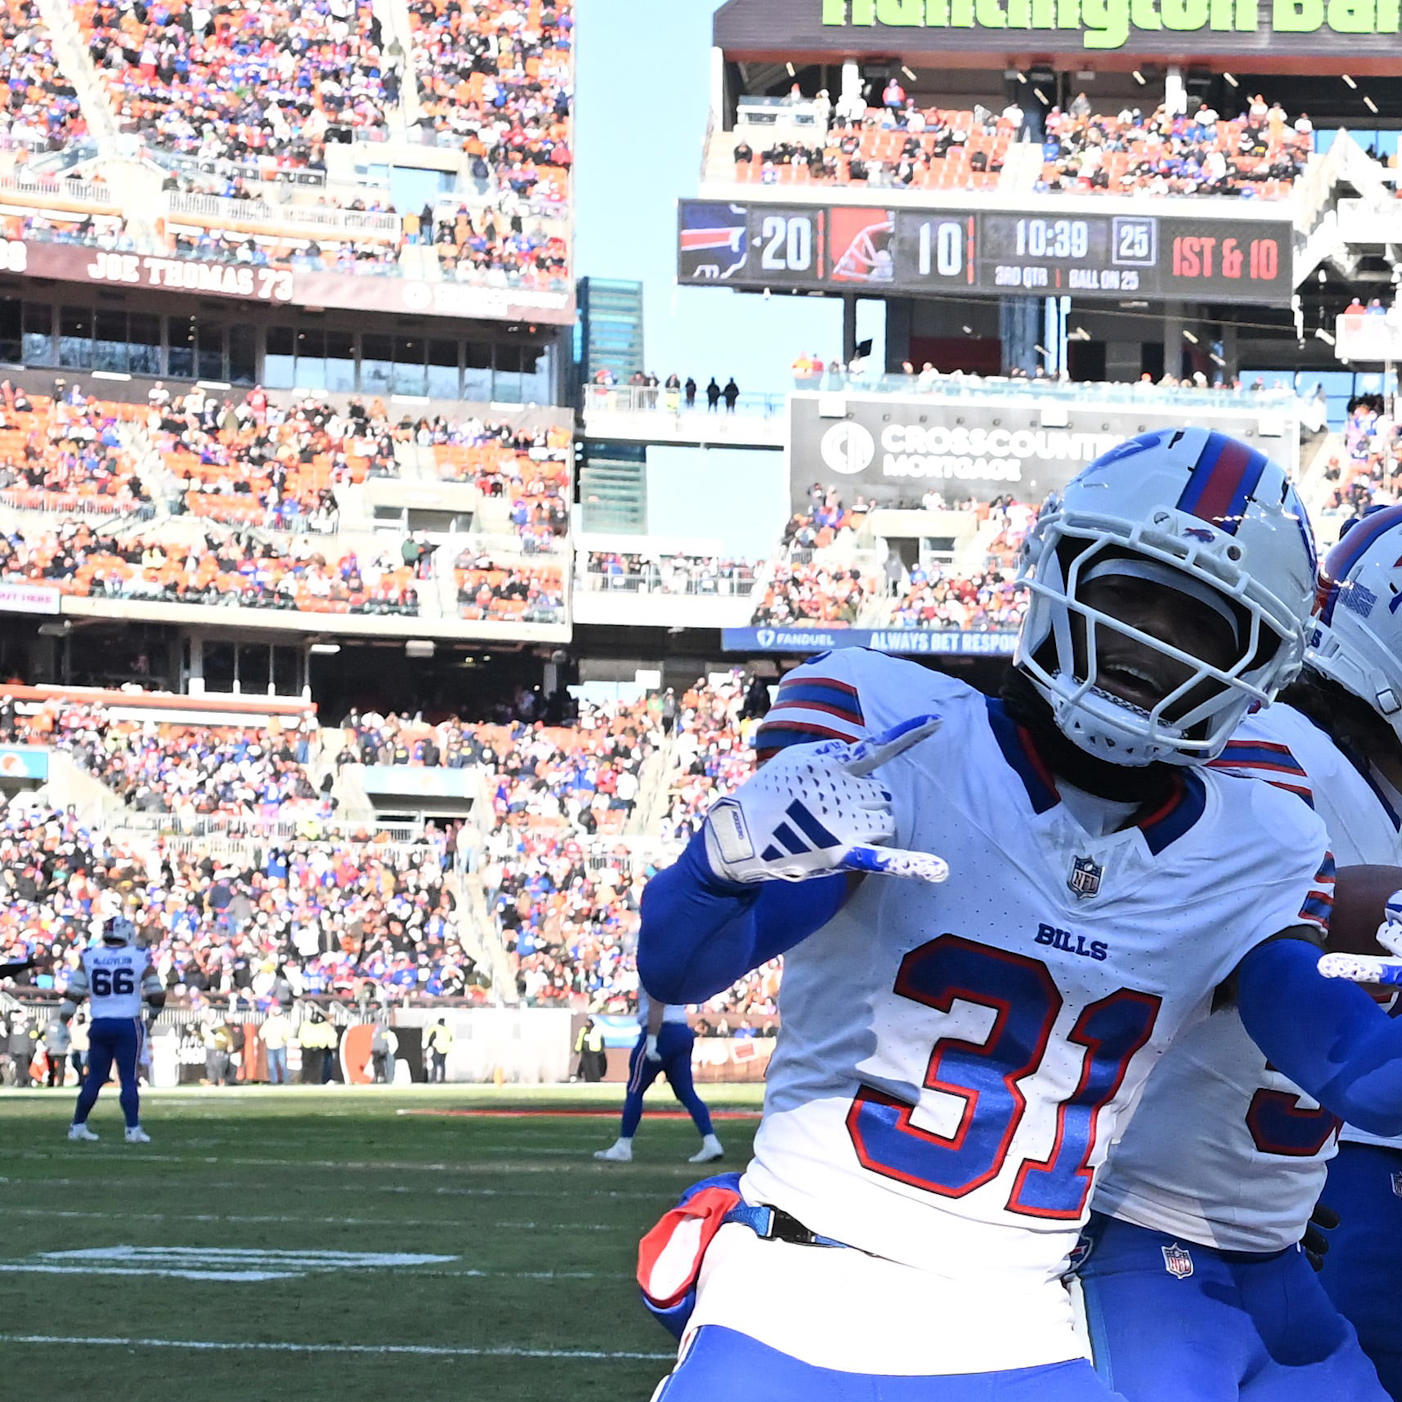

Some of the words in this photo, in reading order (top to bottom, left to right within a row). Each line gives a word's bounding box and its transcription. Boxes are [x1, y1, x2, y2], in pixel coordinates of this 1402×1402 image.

[762, 216, 812, 271] 20
[919, 222, 963, 276] 10
[1016, 219, 1089, 258] 10:39
[1119, 225, 1150, 257] 25
[87, 251, 140, 283] JOE
[143, 257, 254, 296] THOMAS
[258, 267, 294, 301] 73
[1222, 238, 1244, 279] &
[1250, 239, 1279, 281] 10
[1120, 270, 1140, 291] 25
[883, 453, 1022, 482] MORTGAGE
[776, 633, 836, 647] FANDUEL
[870, 631, 929, 651] ALWAYS
[930, 632, 960, 651] BET
[1072, 869, 1100, 894] NFL
[1034, 922, 1109, 962] BILLS
[91, 968, 135, 996] 66
[845, 932, 1163, 1221] 31
